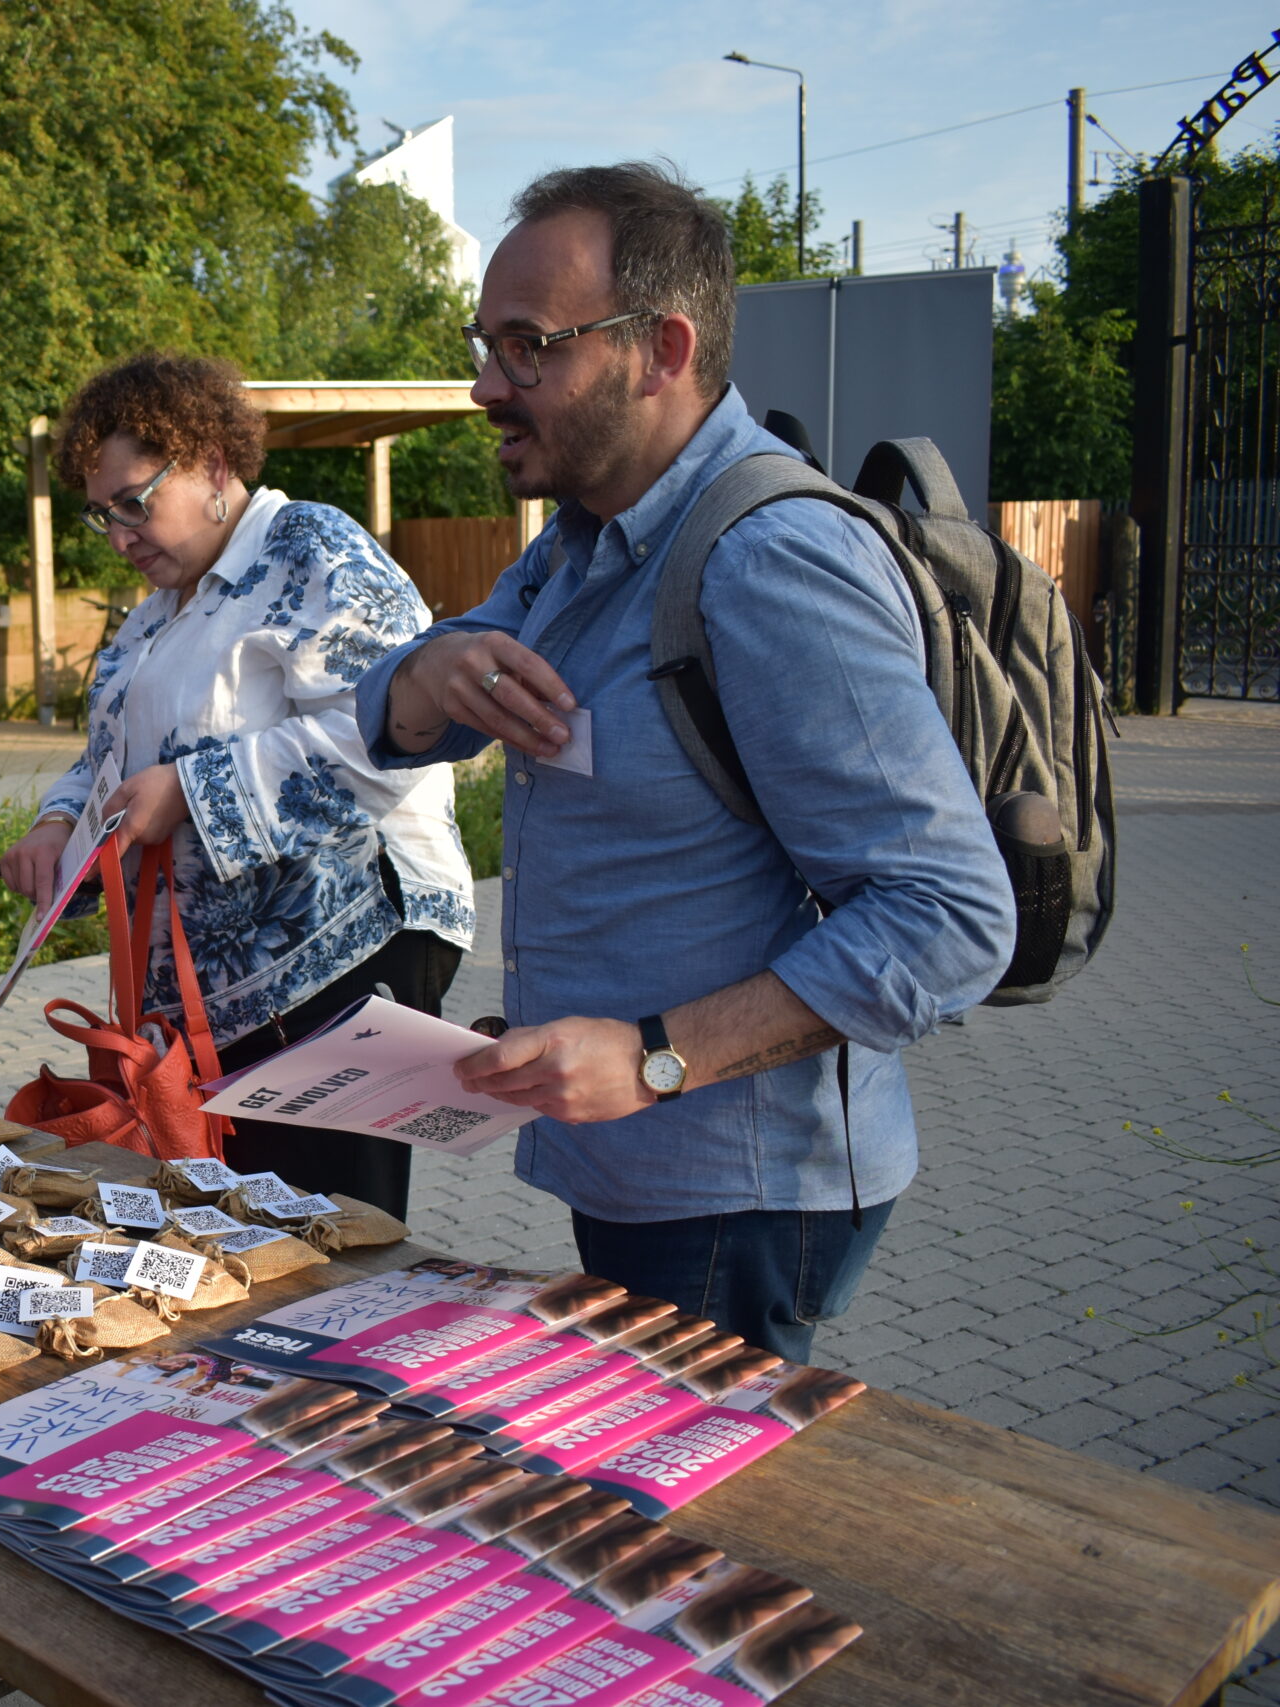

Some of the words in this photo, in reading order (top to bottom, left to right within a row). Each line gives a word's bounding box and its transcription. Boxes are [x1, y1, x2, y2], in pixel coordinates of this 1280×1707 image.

[238, 1087, 283, 1109] GET
[274, 1067, 370, 1115] INVOLVED
[315, 1304, 400, 1319] ARE
[332, 1294, 412, 1310] THE
[288, 1312, 347, 1331] WE
[449, 1320, 502, 1336] IMPACT
[464, 1314, 516, 1330] REPORT
[232, 1328, 312, 1352] nest
[437, 1326, 488, 1341] FUNDER
[382, 1334, 462, 1356] 2024
[357, 1346, 436, 1368] 2023
[434, 1374, 482, 1391] 20
[621, 1398, 658, 1412] IMP
[634, 1393, 670, 1405] REP
[29, 1398, 117, 1424] THE
[606, 1405, 645, 1418] FUN
[6, 1414, 98, 1438] ARE
[567, 1418, 616, 1437] 20
[691, 1423, 752, 1444] IMPACT
[705, 1417, 764, 1437] REPORT
[148, 1438, 205, 1454] IMPACT
[166, 1430, 222, 1446] REPORT
[539, 1431, 591, 1450] 20
[651, 1435, 728, 1459] ABRIDGED
[680, 1430, 740, 1452] FUNDER
[133, 1446, 188, 1462] FUNDER
[624, 1441, 716, 1472] 2024
[68, 1458, 154, 1482] 2024
[598, 1454, 692, 1487] 2023
[36, 1474, 120, 1498] 2023
[132, 1488, 185, 1508] 20
[96, 1504, 152, 1525] 20
[173, 1510, 229, 1530] 20
[139, 1526, 193, 1546] 20
[180, 1544, 237, 1565] 20
[451, 1559, 490, 1571] REP
[359, 1593, 422, 1616] 20
[468, 1594, 516, 1610] IMP
[323, 1610, 387, 1635] 20
[516, 1621, 560, 1638] IMP
[535, 1611, 578, 1628] REP
[399, 1623, 465, 1649] 20
[498, 1631, 541, 1648] FUN
[362, 1642, 432, 1670] 20
[564, 1647, 638, 1678] IMPACT
[585, 1637, 657, 1667] REPORT
[527, 1668, 598, 1699] ABRIDG
[546, 1658, 618, 1688] FUNDER
[491, 1678, 577, 1707] 202
